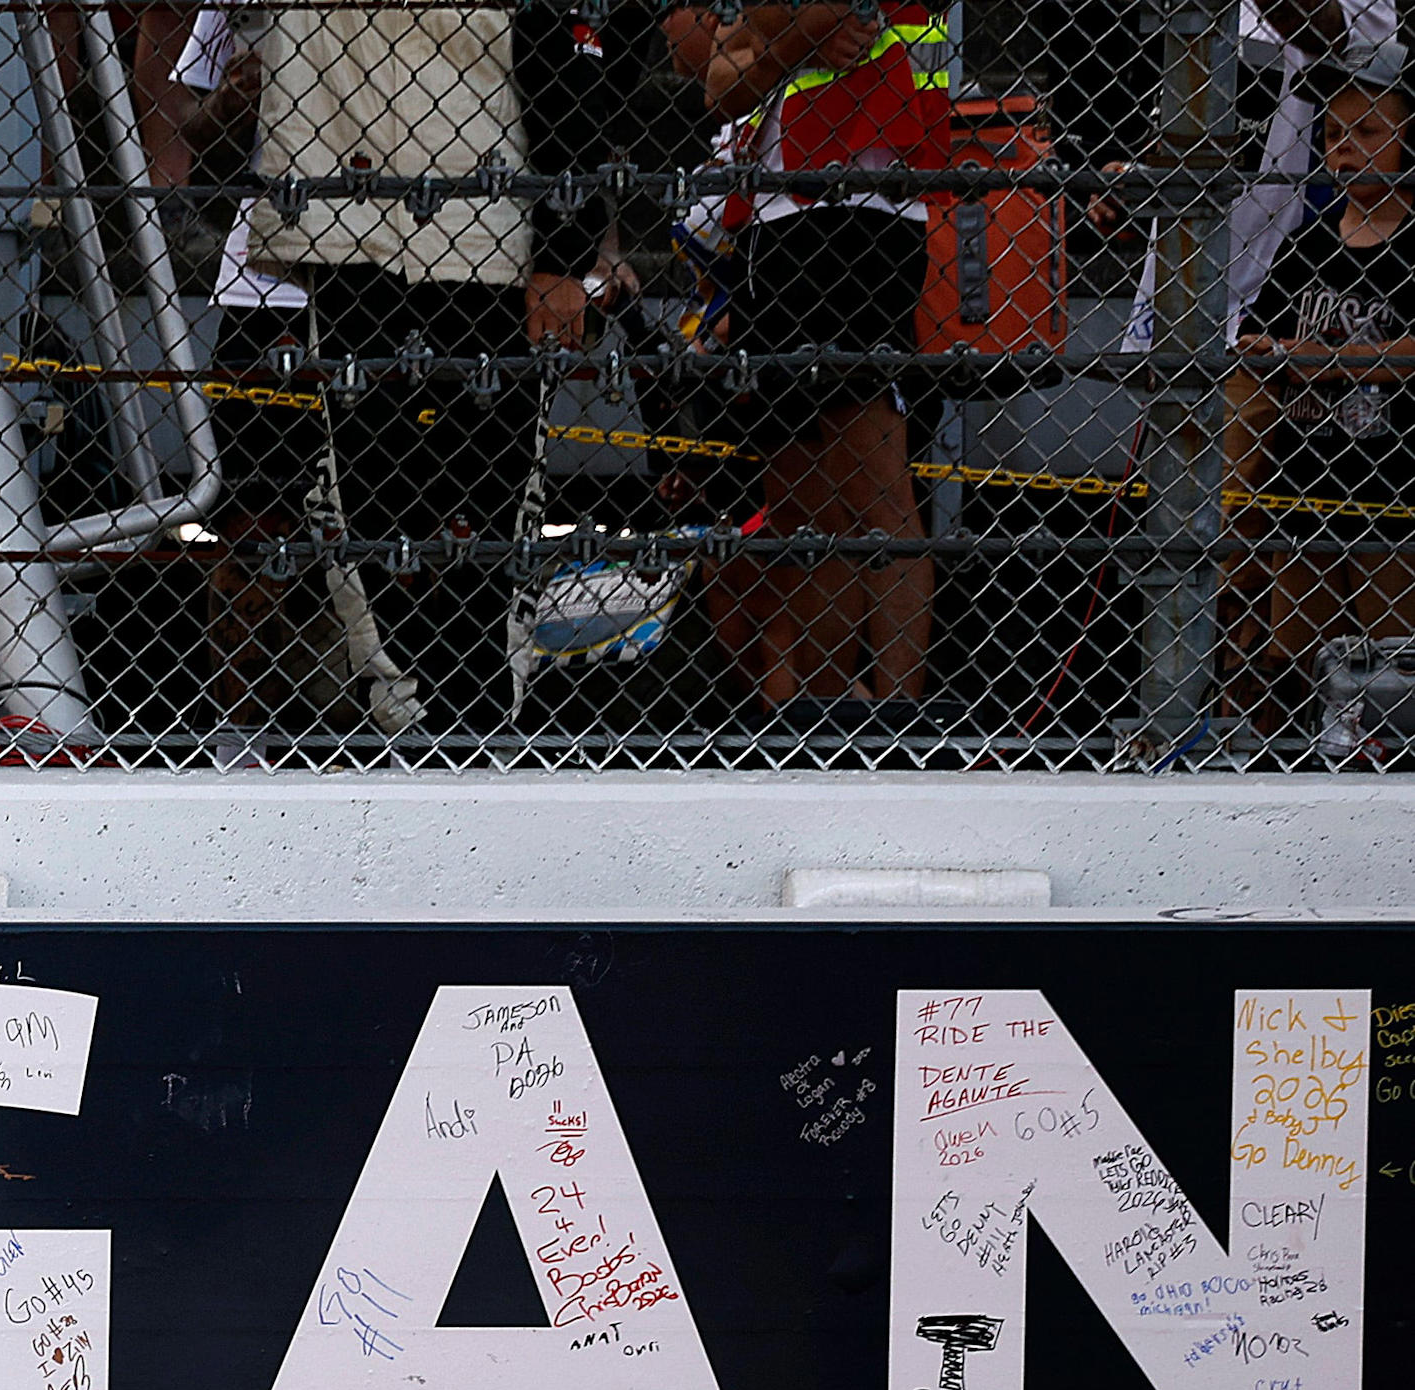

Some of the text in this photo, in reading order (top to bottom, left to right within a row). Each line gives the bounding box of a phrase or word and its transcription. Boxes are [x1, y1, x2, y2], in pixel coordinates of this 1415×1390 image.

[917, 996, 983, 1024] #77
[1236, 998, 1307, 1032] Nick
[913, 1020, 1055, 1046] RIDE THE
[1245, 1035, 1369, 1087] Shelby
[1252, 1074, 1349, 1117] 2026
[939, 1146, 986, 1167] 2026
[1231, 1122, 1363, 1191] Go Denny
[531, 1180, 588, 1215] 24
[1241, 1193, 1325, 1241] CLEARY
